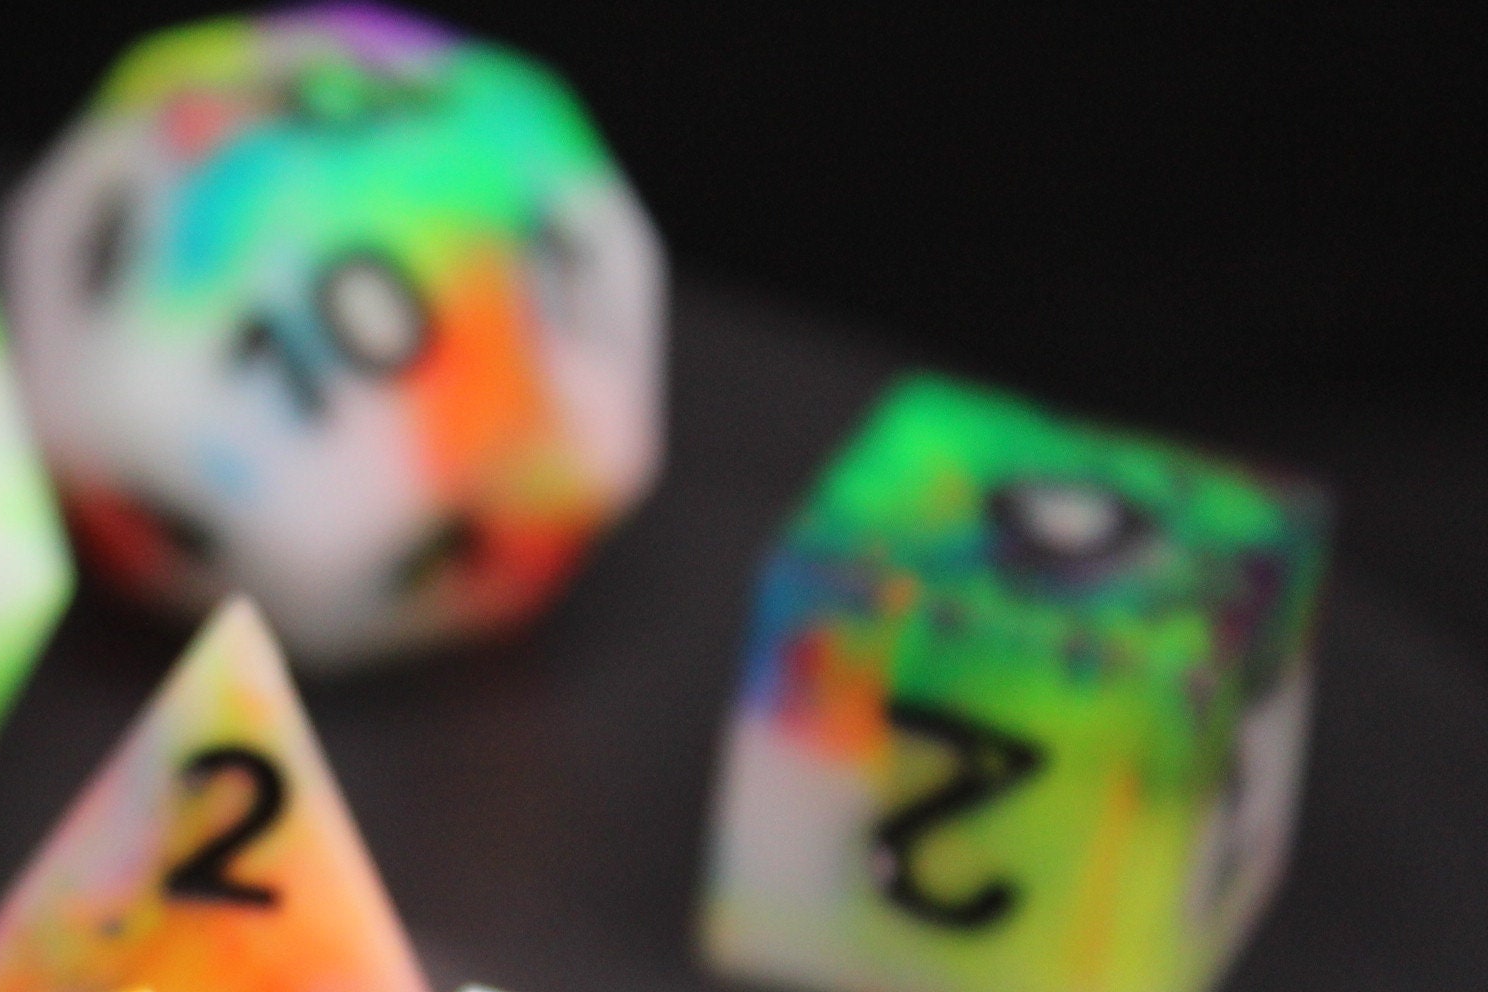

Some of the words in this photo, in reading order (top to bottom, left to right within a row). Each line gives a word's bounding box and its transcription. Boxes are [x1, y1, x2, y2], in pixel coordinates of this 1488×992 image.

[229, 243, 437, 428] 10
[166, 748, 288, 907] 2
[870, 696, 1046, 938] 2
